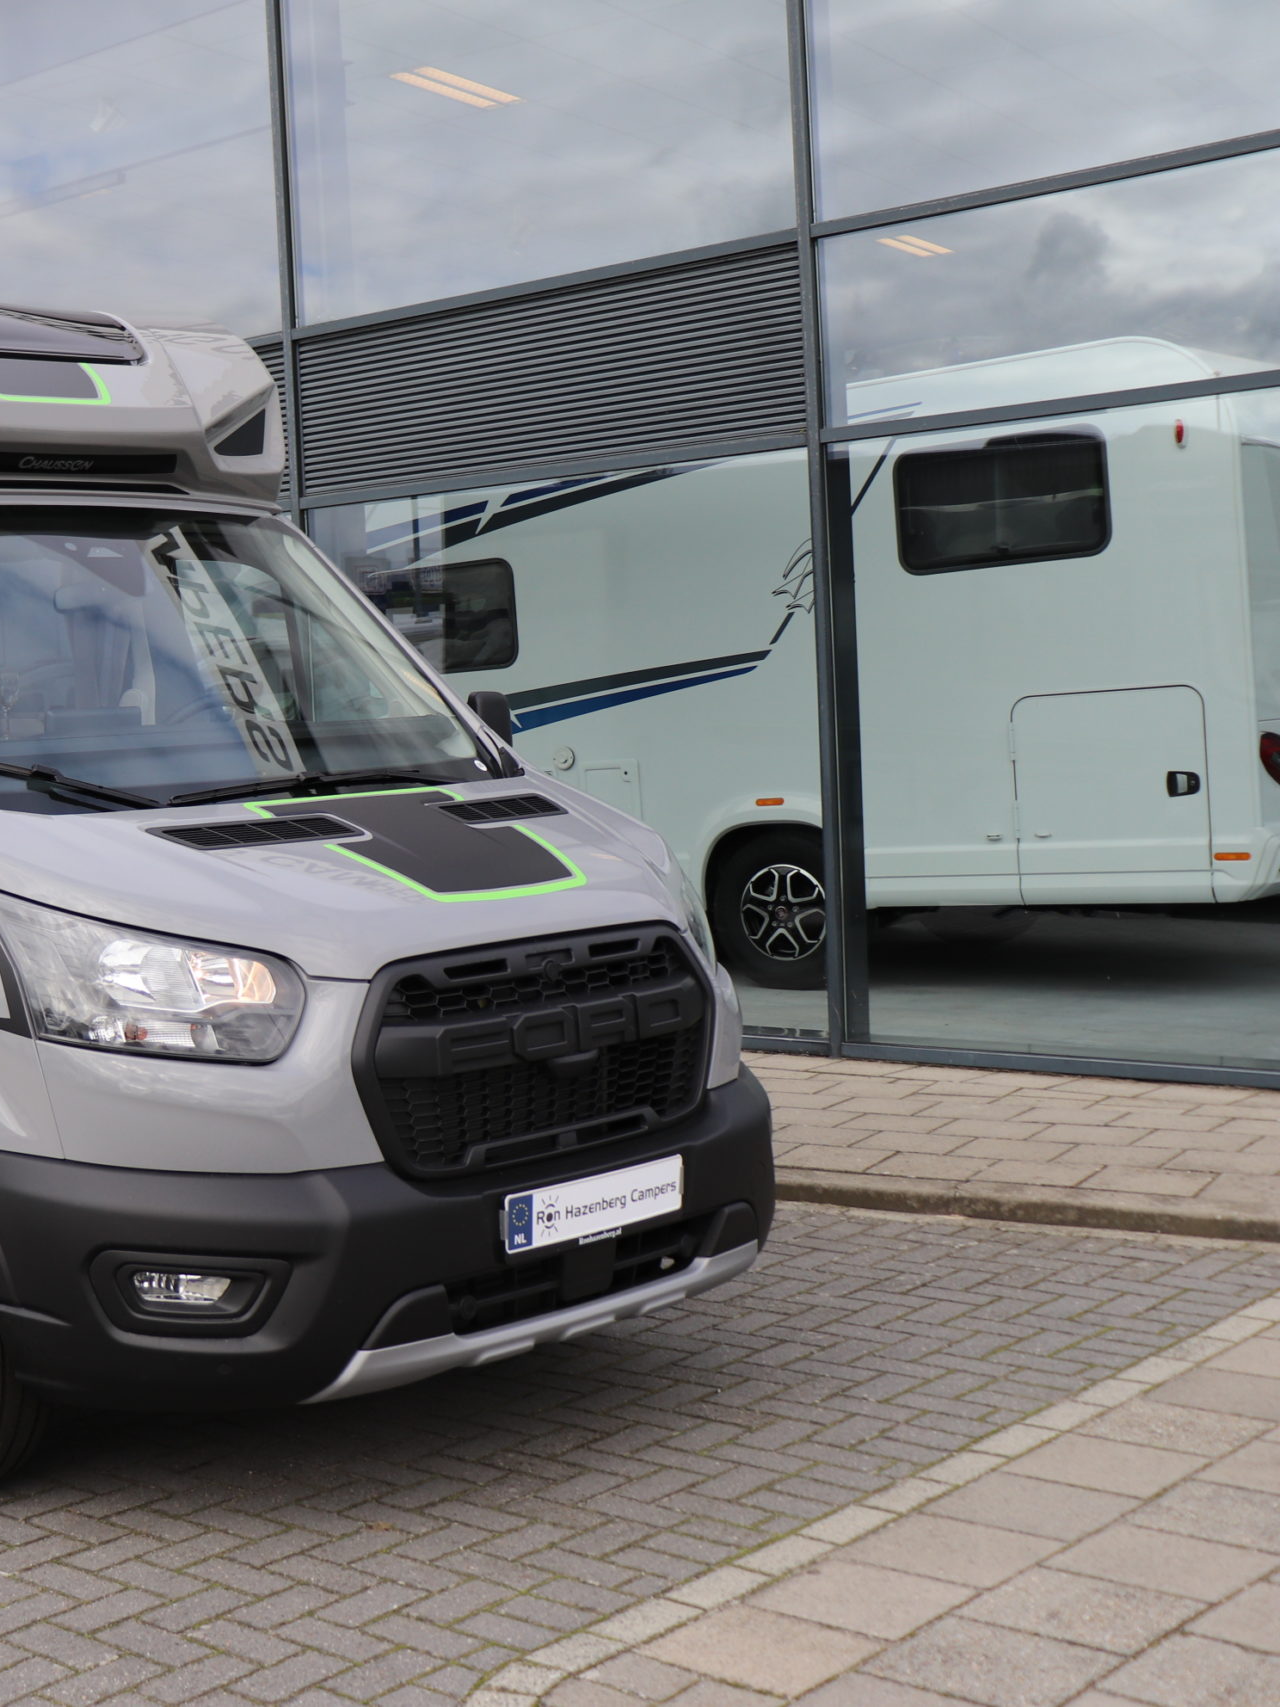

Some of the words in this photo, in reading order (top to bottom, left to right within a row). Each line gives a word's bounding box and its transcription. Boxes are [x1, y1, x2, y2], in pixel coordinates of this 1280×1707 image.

[565, 1194, 627, 1220] Hazenberg
[630, 1180, 677, 1203] Campers
[513, 1232, 528, 1246] NL
